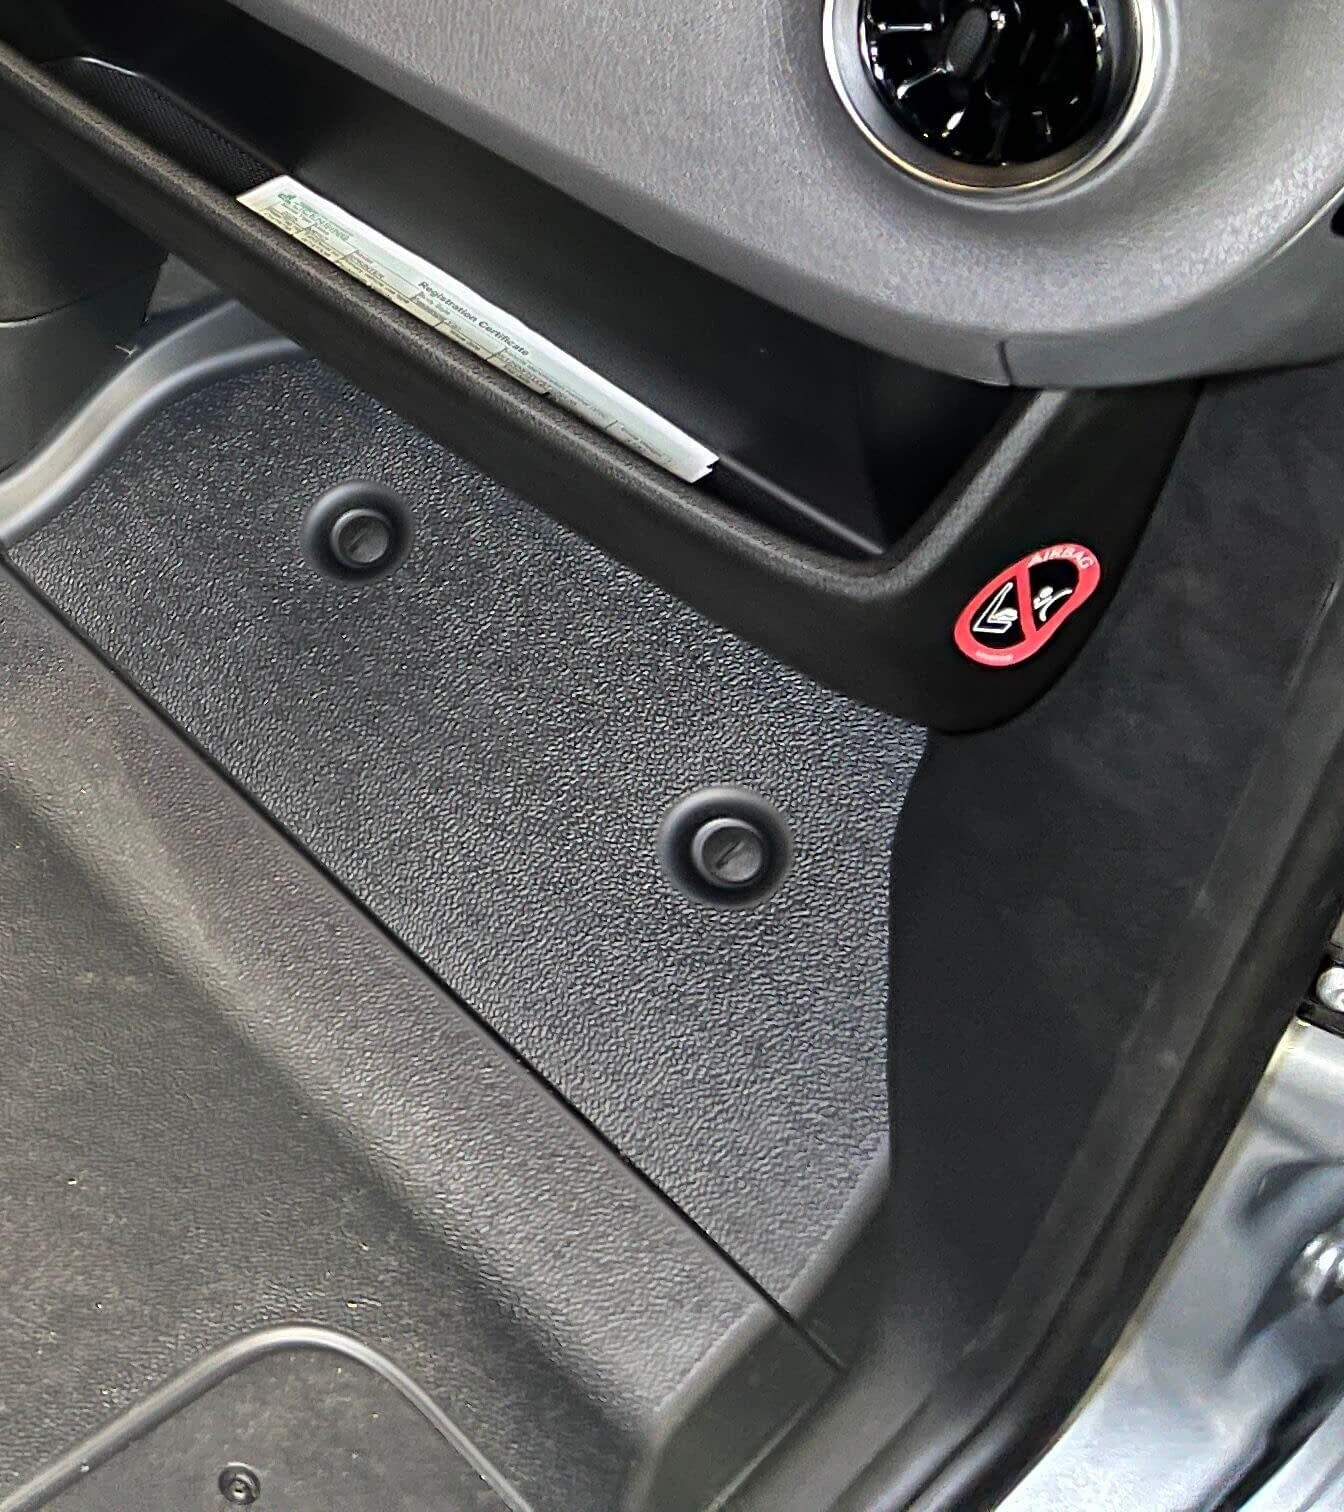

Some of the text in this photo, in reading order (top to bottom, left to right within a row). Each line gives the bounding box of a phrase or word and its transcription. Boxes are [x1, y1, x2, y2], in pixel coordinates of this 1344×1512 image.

[418, 281, 477, 322] Registration
[477, 319, 530, 356] Certificate
[1028, 547, 1094, 569] AIRBAG
